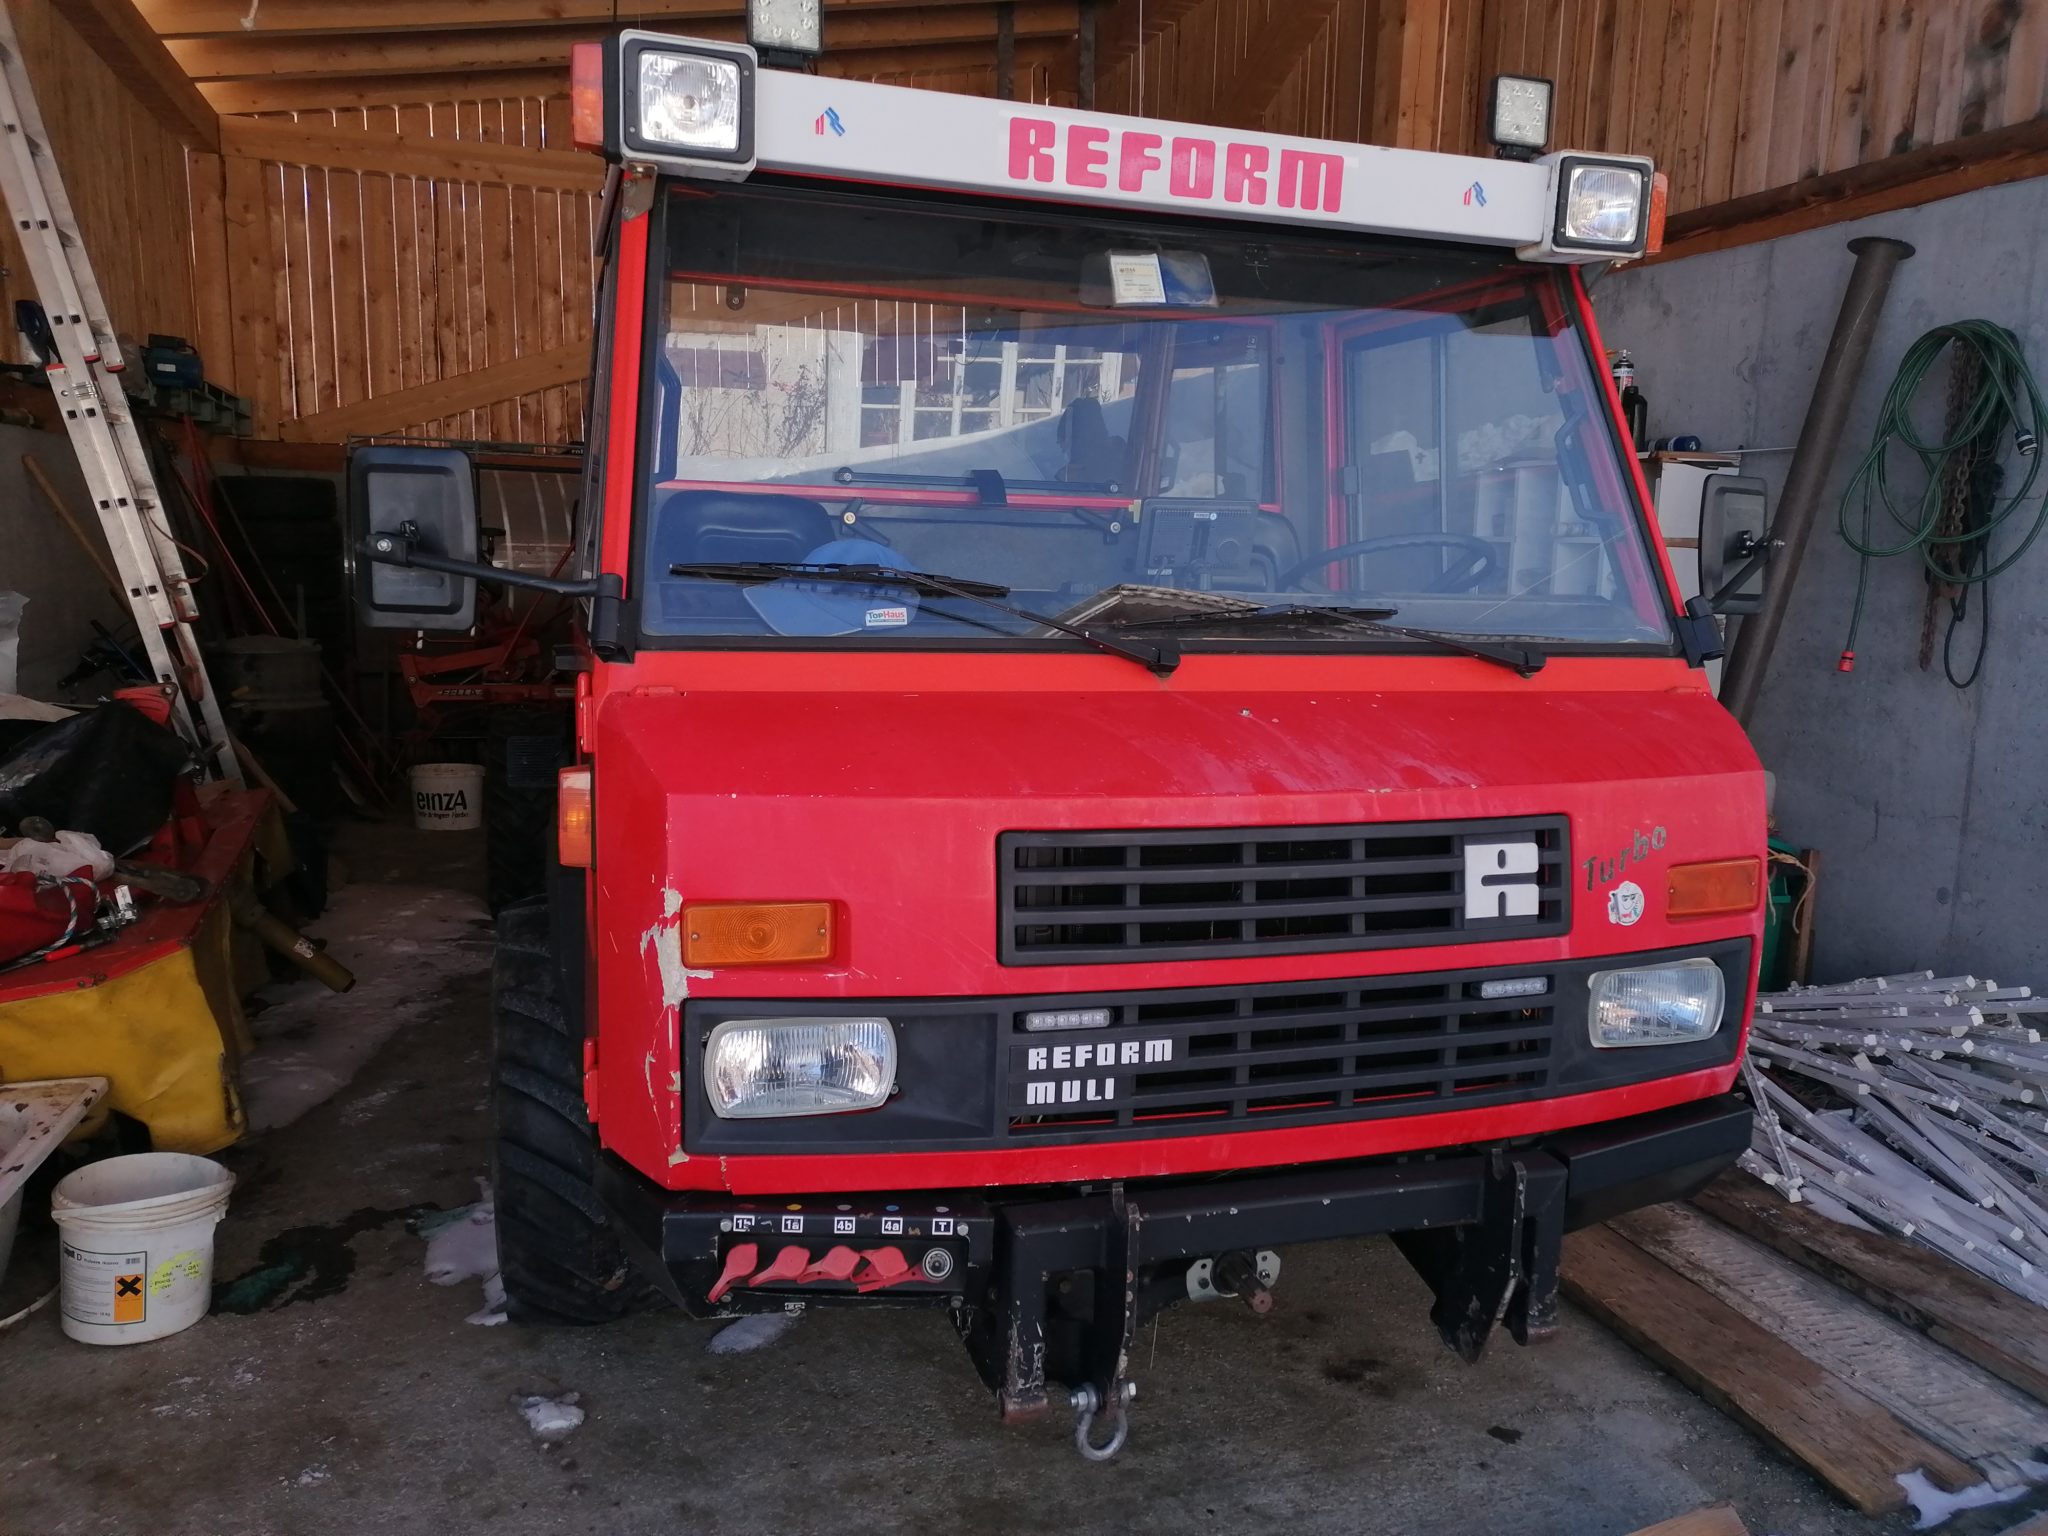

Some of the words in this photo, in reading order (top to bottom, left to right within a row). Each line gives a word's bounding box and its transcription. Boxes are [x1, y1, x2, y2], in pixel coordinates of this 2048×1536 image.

[1008, 117, 1344, 213] REFORM
[868, 610, 905, 619] TopHaus
[1582, 826, 1667, 892] Turbo
[1028, 1039, 1173, 1070] REFORM
[1026, 1078, 1115, 1105] MULI
[785, 1219, 799, 1230] 1a
[837, 1220, 853, 1231] 4b
[885, 1220, 900, 1231] 4a
